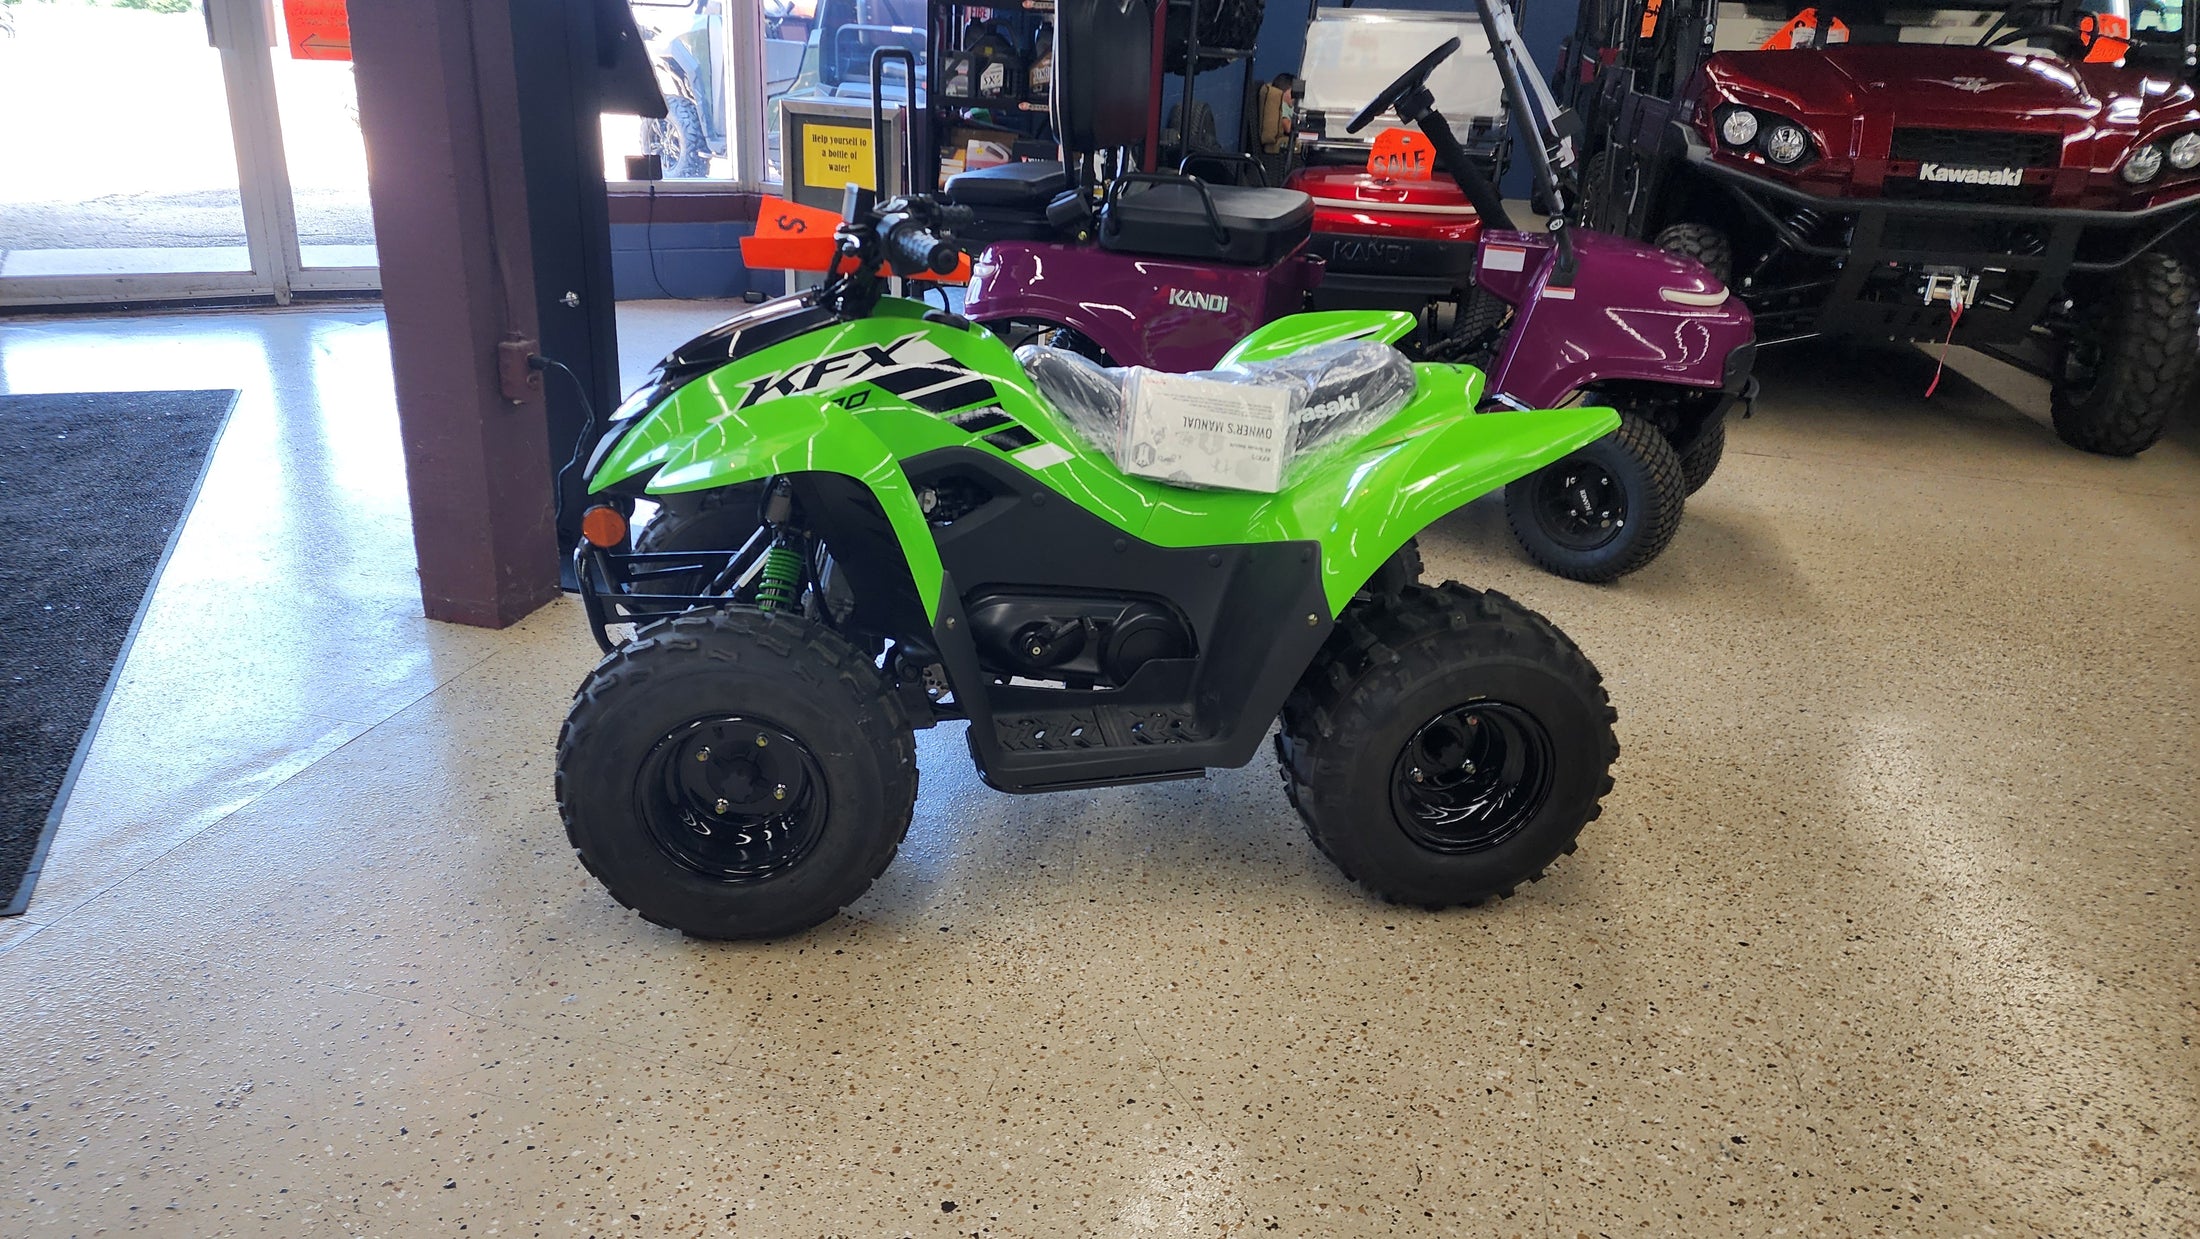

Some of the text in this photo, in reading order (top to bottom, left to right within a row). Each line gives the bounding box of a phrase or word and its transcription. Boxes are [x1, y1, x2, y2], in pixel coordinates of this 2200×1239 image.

[812, 133, 867, 147] Help yourself to
[822, 149, 858, 161] a bottle of
[1373, 149, 1427, 176] SALE
[828, 163, 851, 174] water!
[1919, 163, 2025, 187] Kawasaki
[1332, 240, 1412, 264] KANDI
[1168, 287, 1229, 314] KANDI
[737, 334, 920, 411] KFX
[1182, 416, 1274, 440] OWNER'S MANUAL
